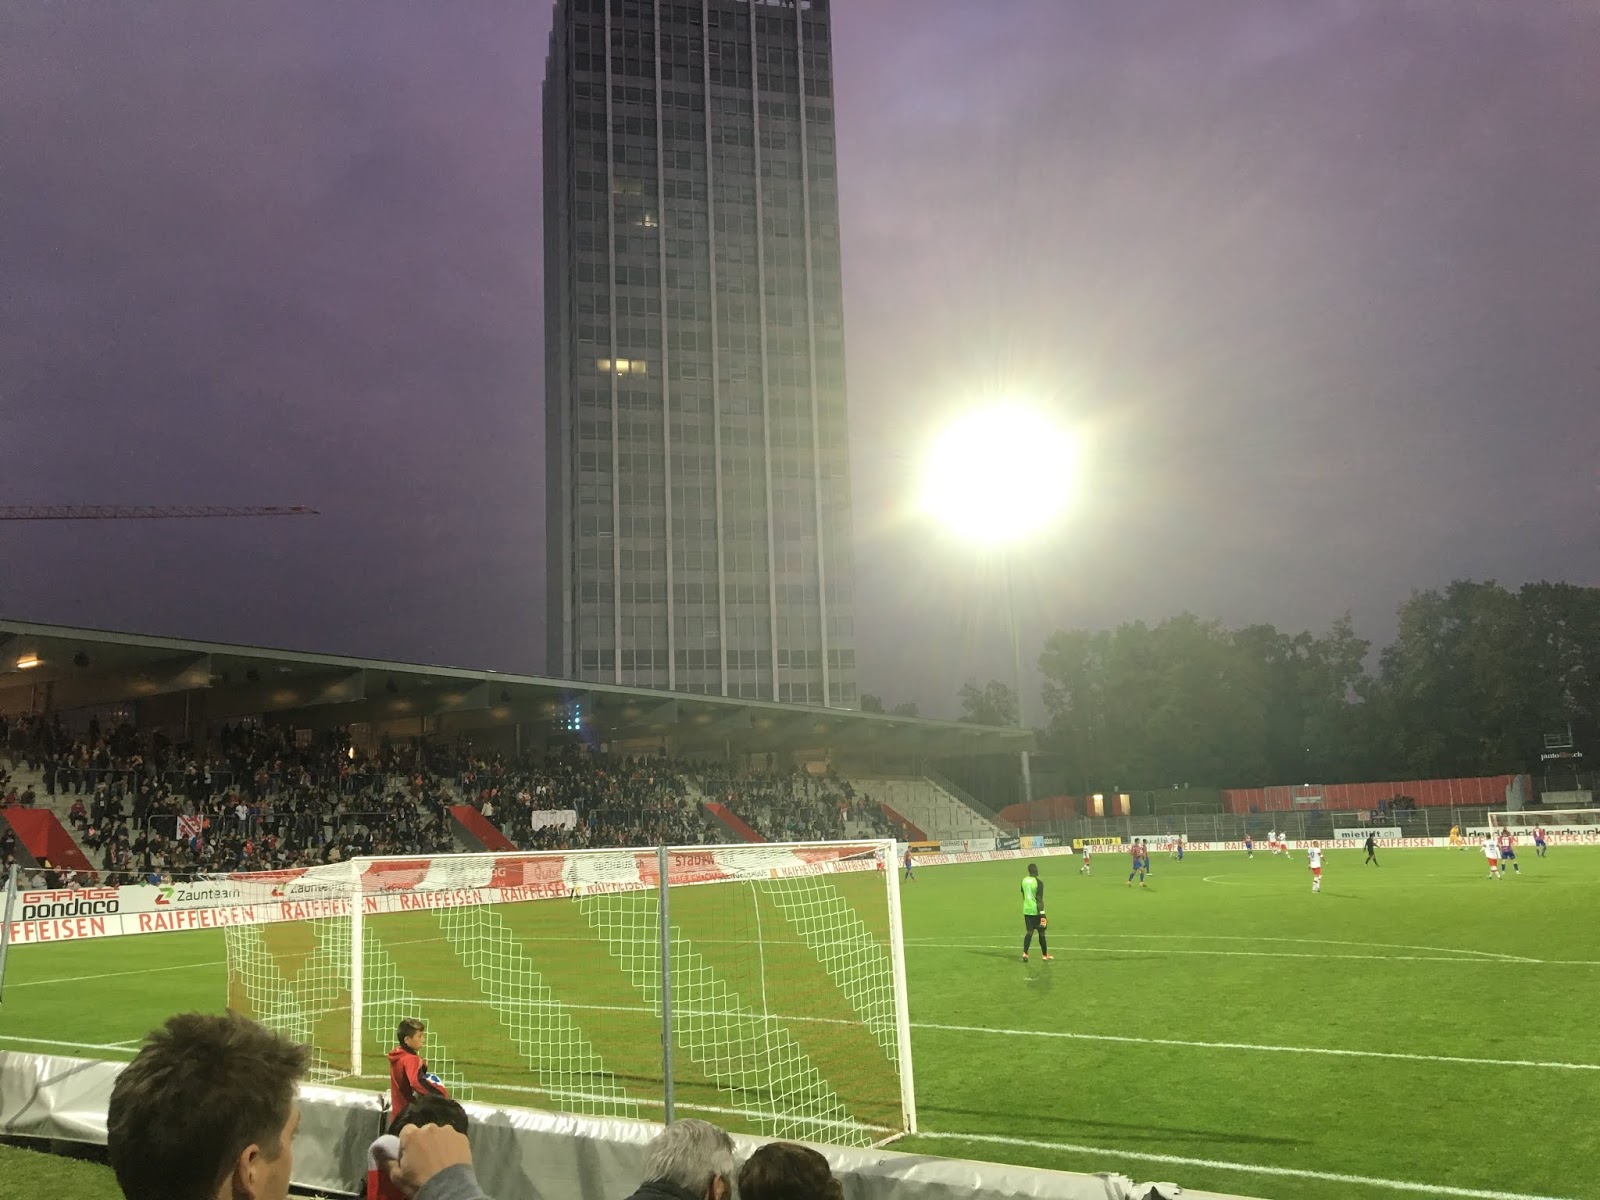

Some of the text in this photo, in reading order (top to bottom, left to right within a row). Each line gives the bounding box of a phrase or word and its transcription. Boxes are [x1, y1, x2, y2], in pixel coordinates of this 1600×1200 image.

[1224, 841, 1282, 850] RAIFEISEN
[1297, 840, 1356, 849] RAIFEISEN
[1545, 834, 1600, 843] AIFFEISE
[1092, 844, 1145, 853] RAIFFEIS
[1156, 842, 1210, 851] RAFEISEN
[783, 862, 824, 877] RAIFFEISEN
[833, 859, 872, 873] RAIFFEISEN
[400, 889, 483, 910] RAIFFEISEN
[501, 883, 571, 903] RAIFFEISEN
[23, 898, 119, 921] pondaco
[281, 896, 378, 920] RAIFFEIN
[138, 905, 255, 932] RAIFFEISEN
